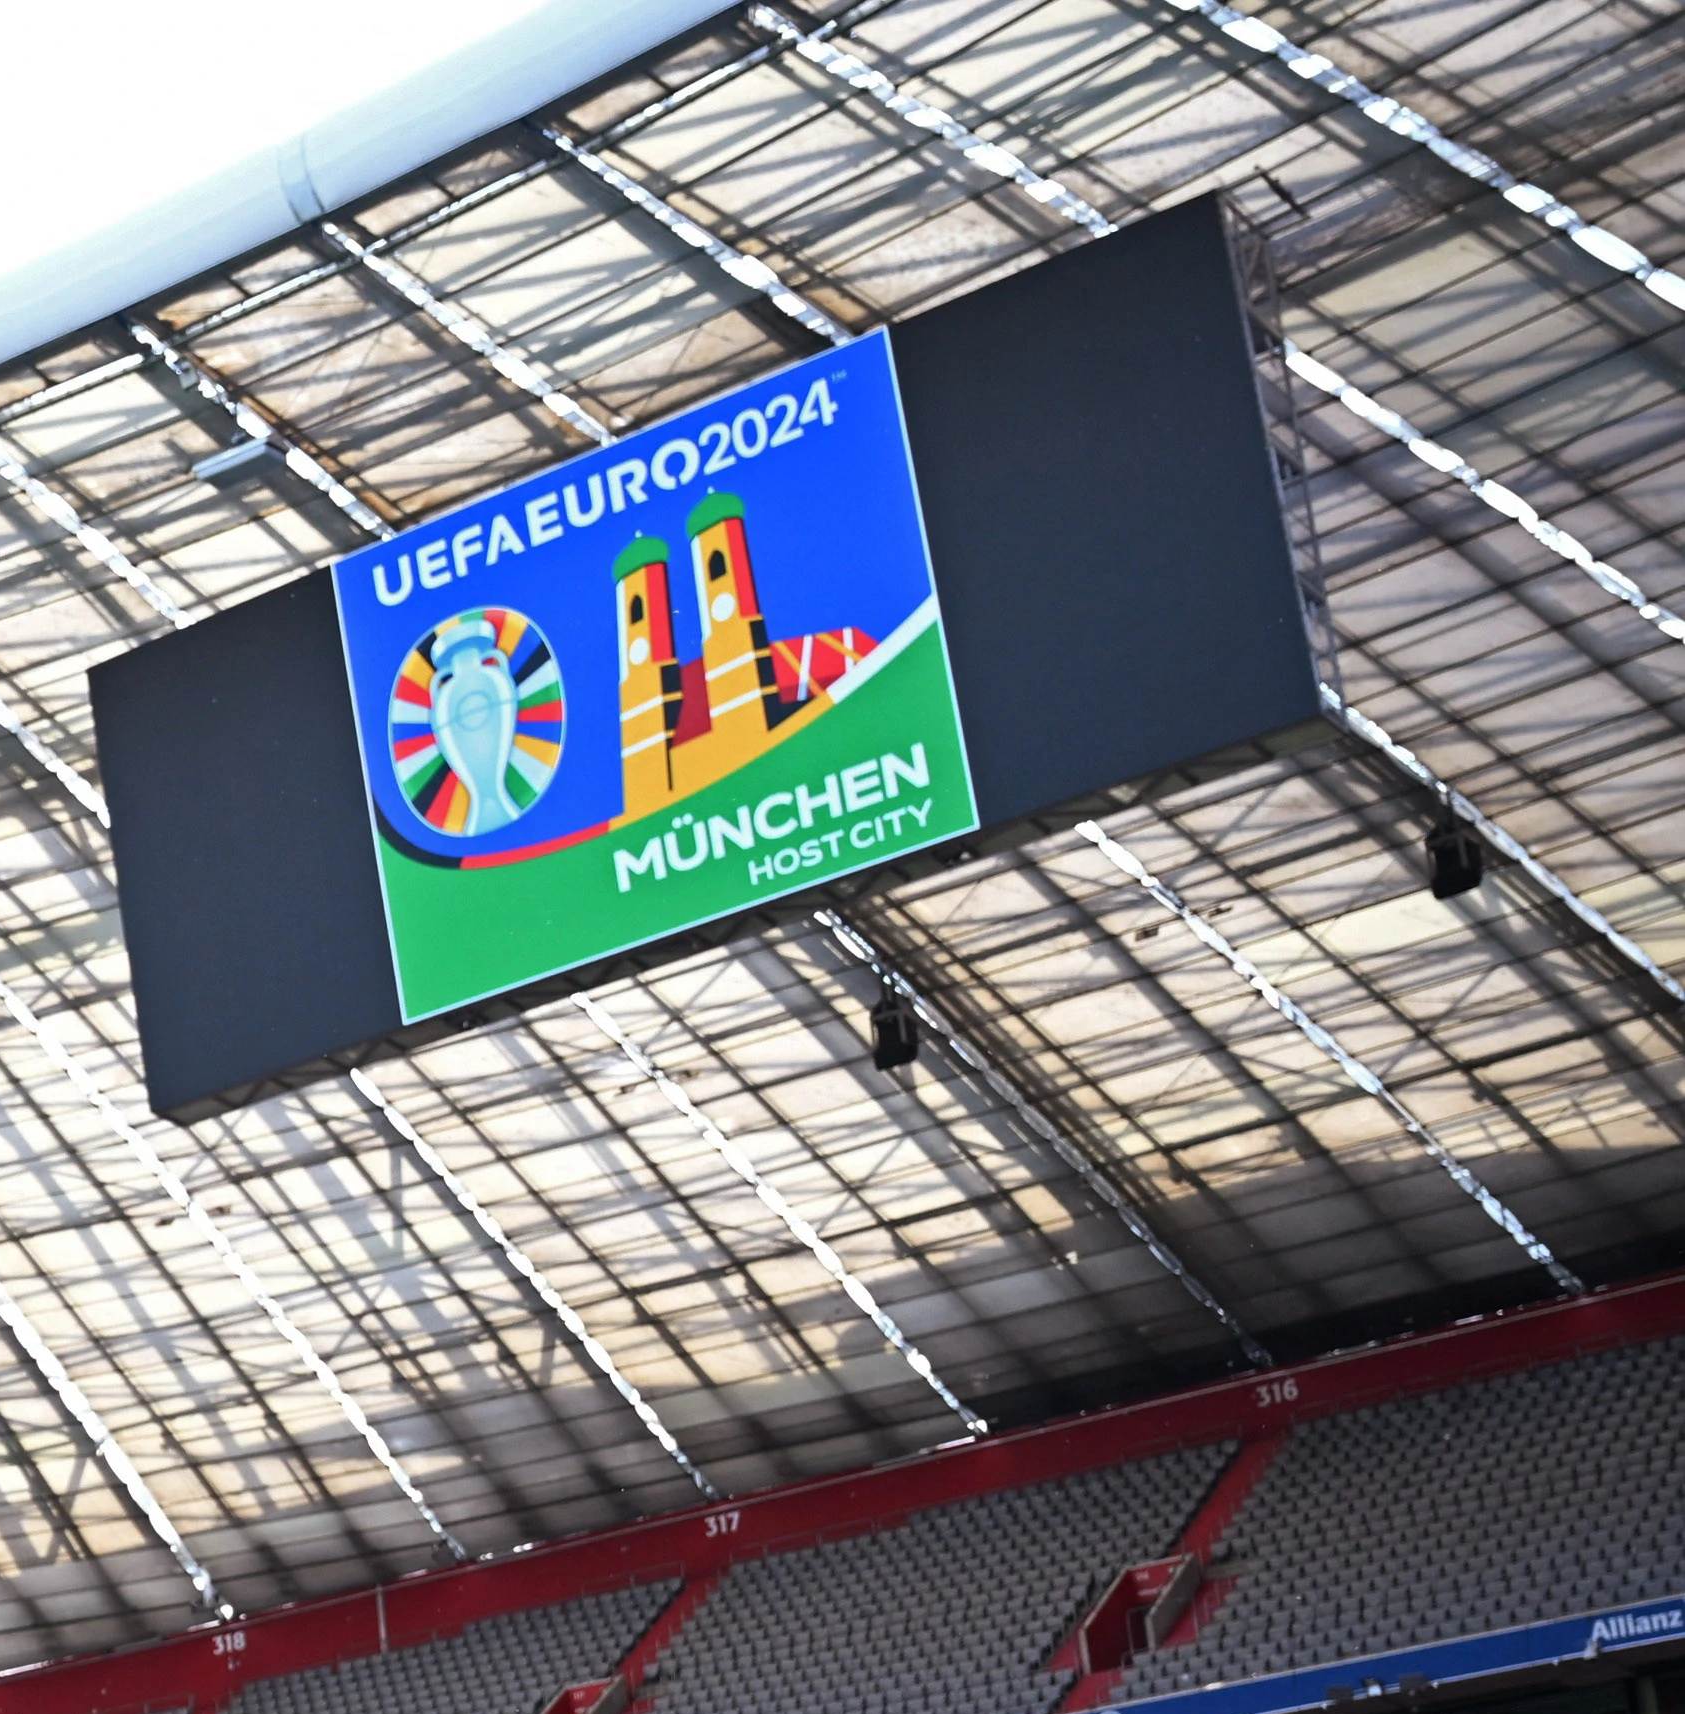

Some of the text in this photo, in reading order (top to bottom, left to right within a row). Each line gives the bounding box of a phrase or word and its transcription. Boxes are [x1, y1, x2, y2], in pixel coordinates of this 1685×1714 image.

[613, 742, 930, 893] MÜNCHEN
[748, 799, 933, 885] HOST CITY
[1256, 1378, 1299, 1408] 316
[704, 1511, 740, 1537] 317
[1591, 1609, 1683, 1642] Allianz
[212, 1631, 246, 1655] 318
